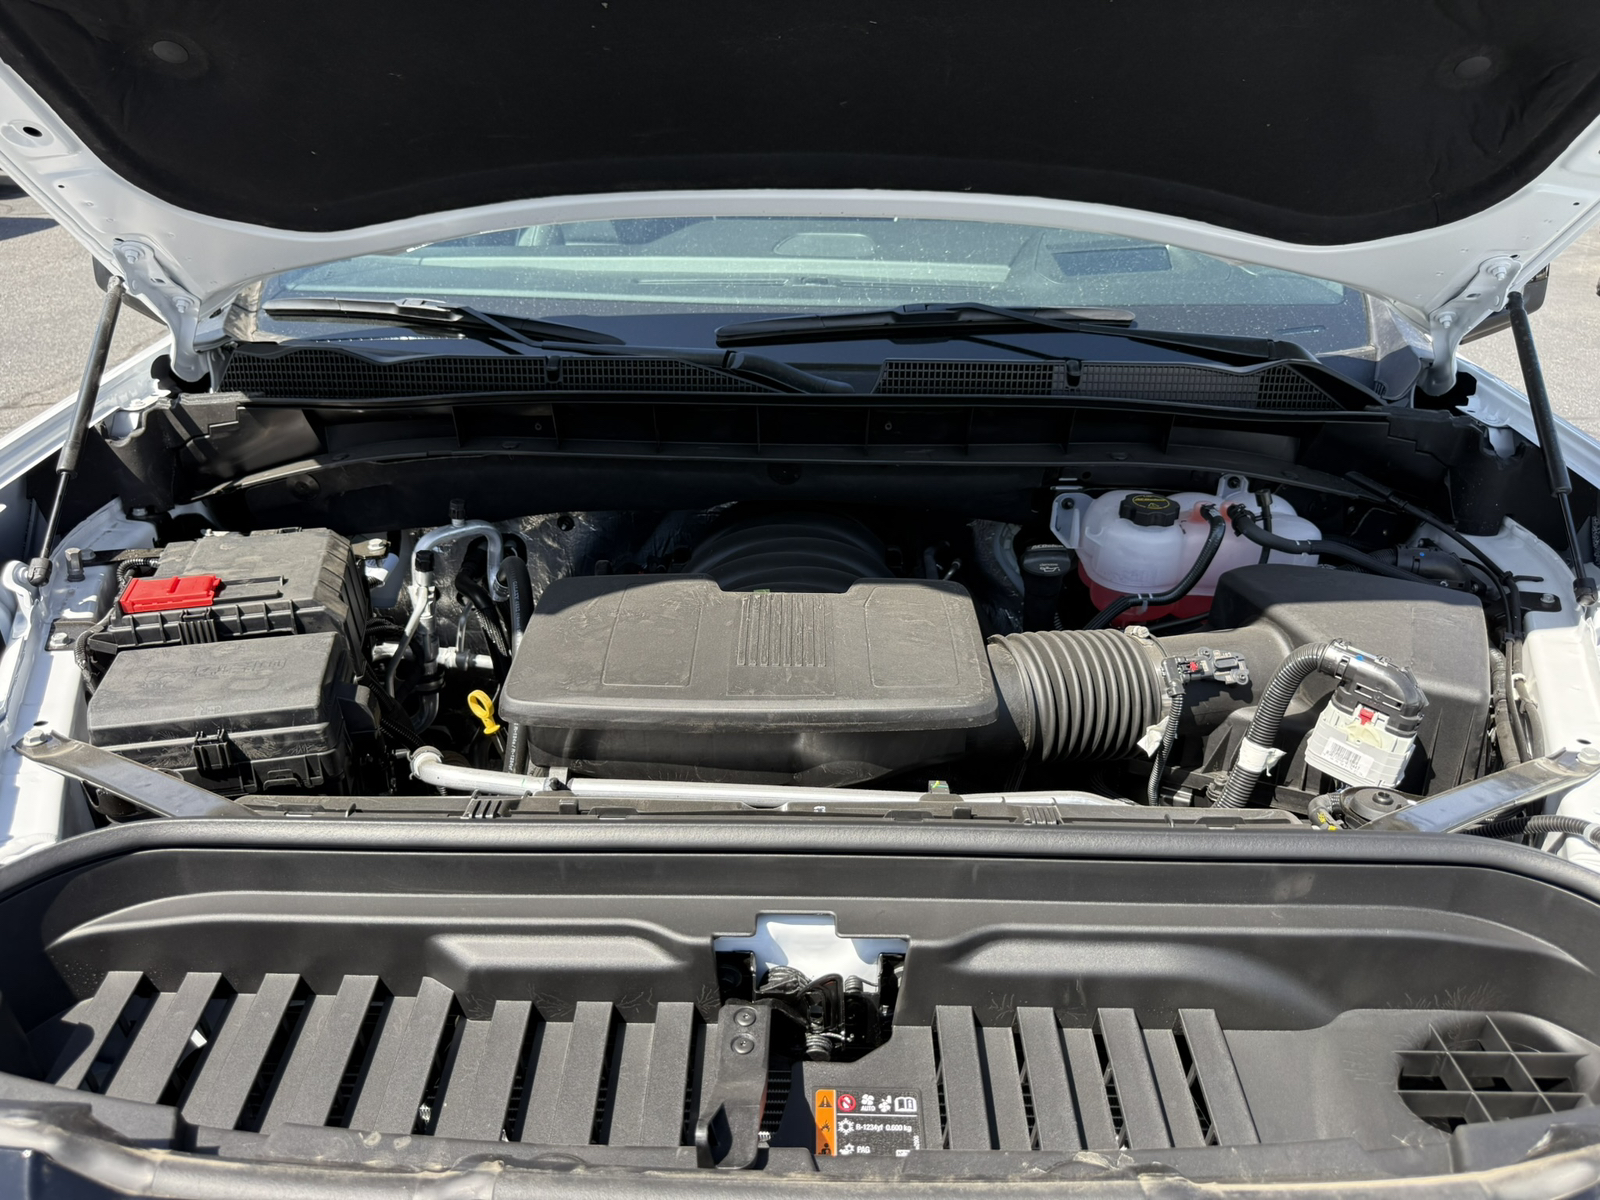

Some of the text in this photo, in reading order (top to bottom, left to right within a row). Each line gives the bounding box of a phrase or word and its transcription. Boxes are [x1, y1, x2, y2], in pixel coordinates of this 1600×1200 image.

[508, 748, 516, 770] R-1234yf
[903, 1124, 912, 1133] kg
[856, 1145, 871, 1154] PAG
